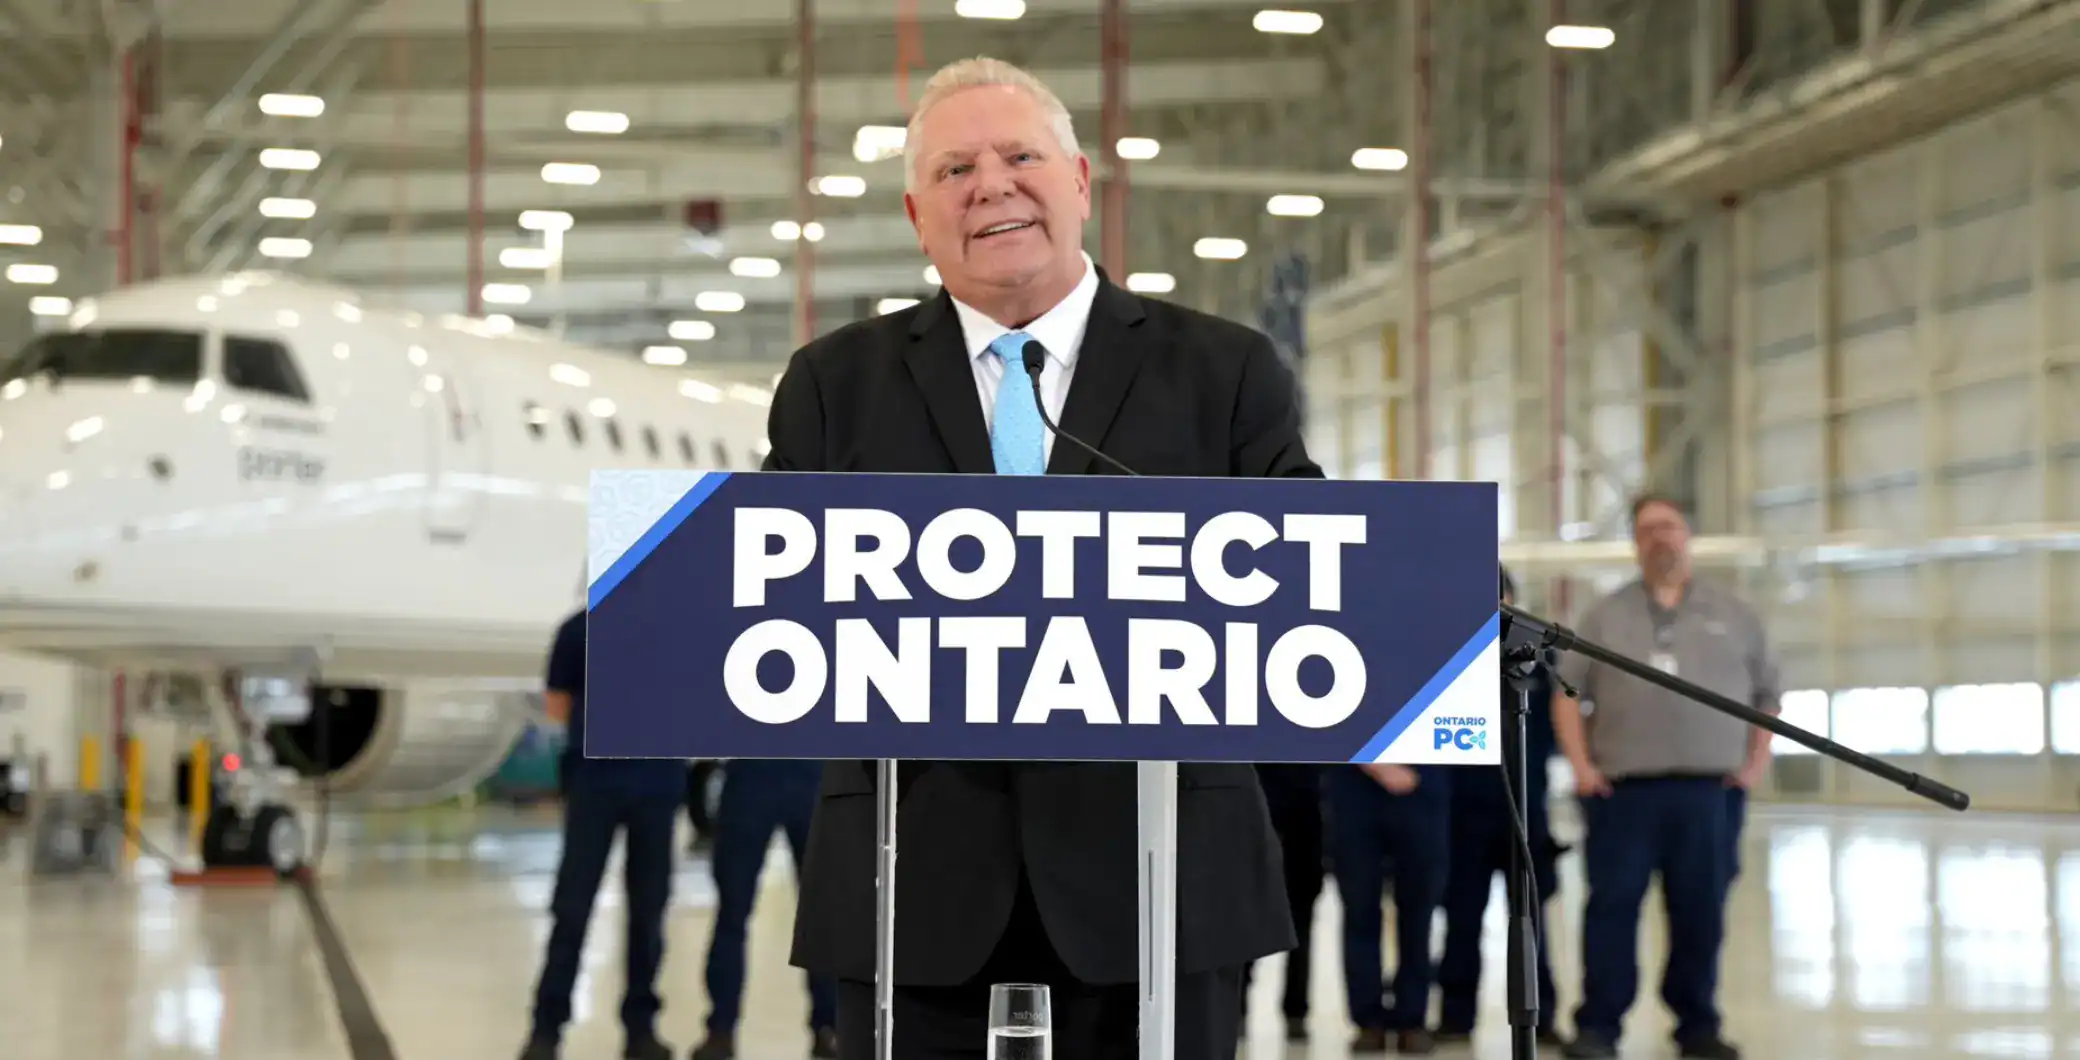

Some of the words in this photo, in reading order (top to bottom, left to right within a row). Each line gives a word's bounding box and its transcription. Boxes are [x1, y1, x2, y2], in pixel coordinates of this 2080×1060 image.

[733, 507, 1367, 611] PROTECT
[723, 616, 1367, 729] ONTARIO
[1433, 716, 1487, 727] ONTARIO
[1433, 727, 1475, 751] PC
